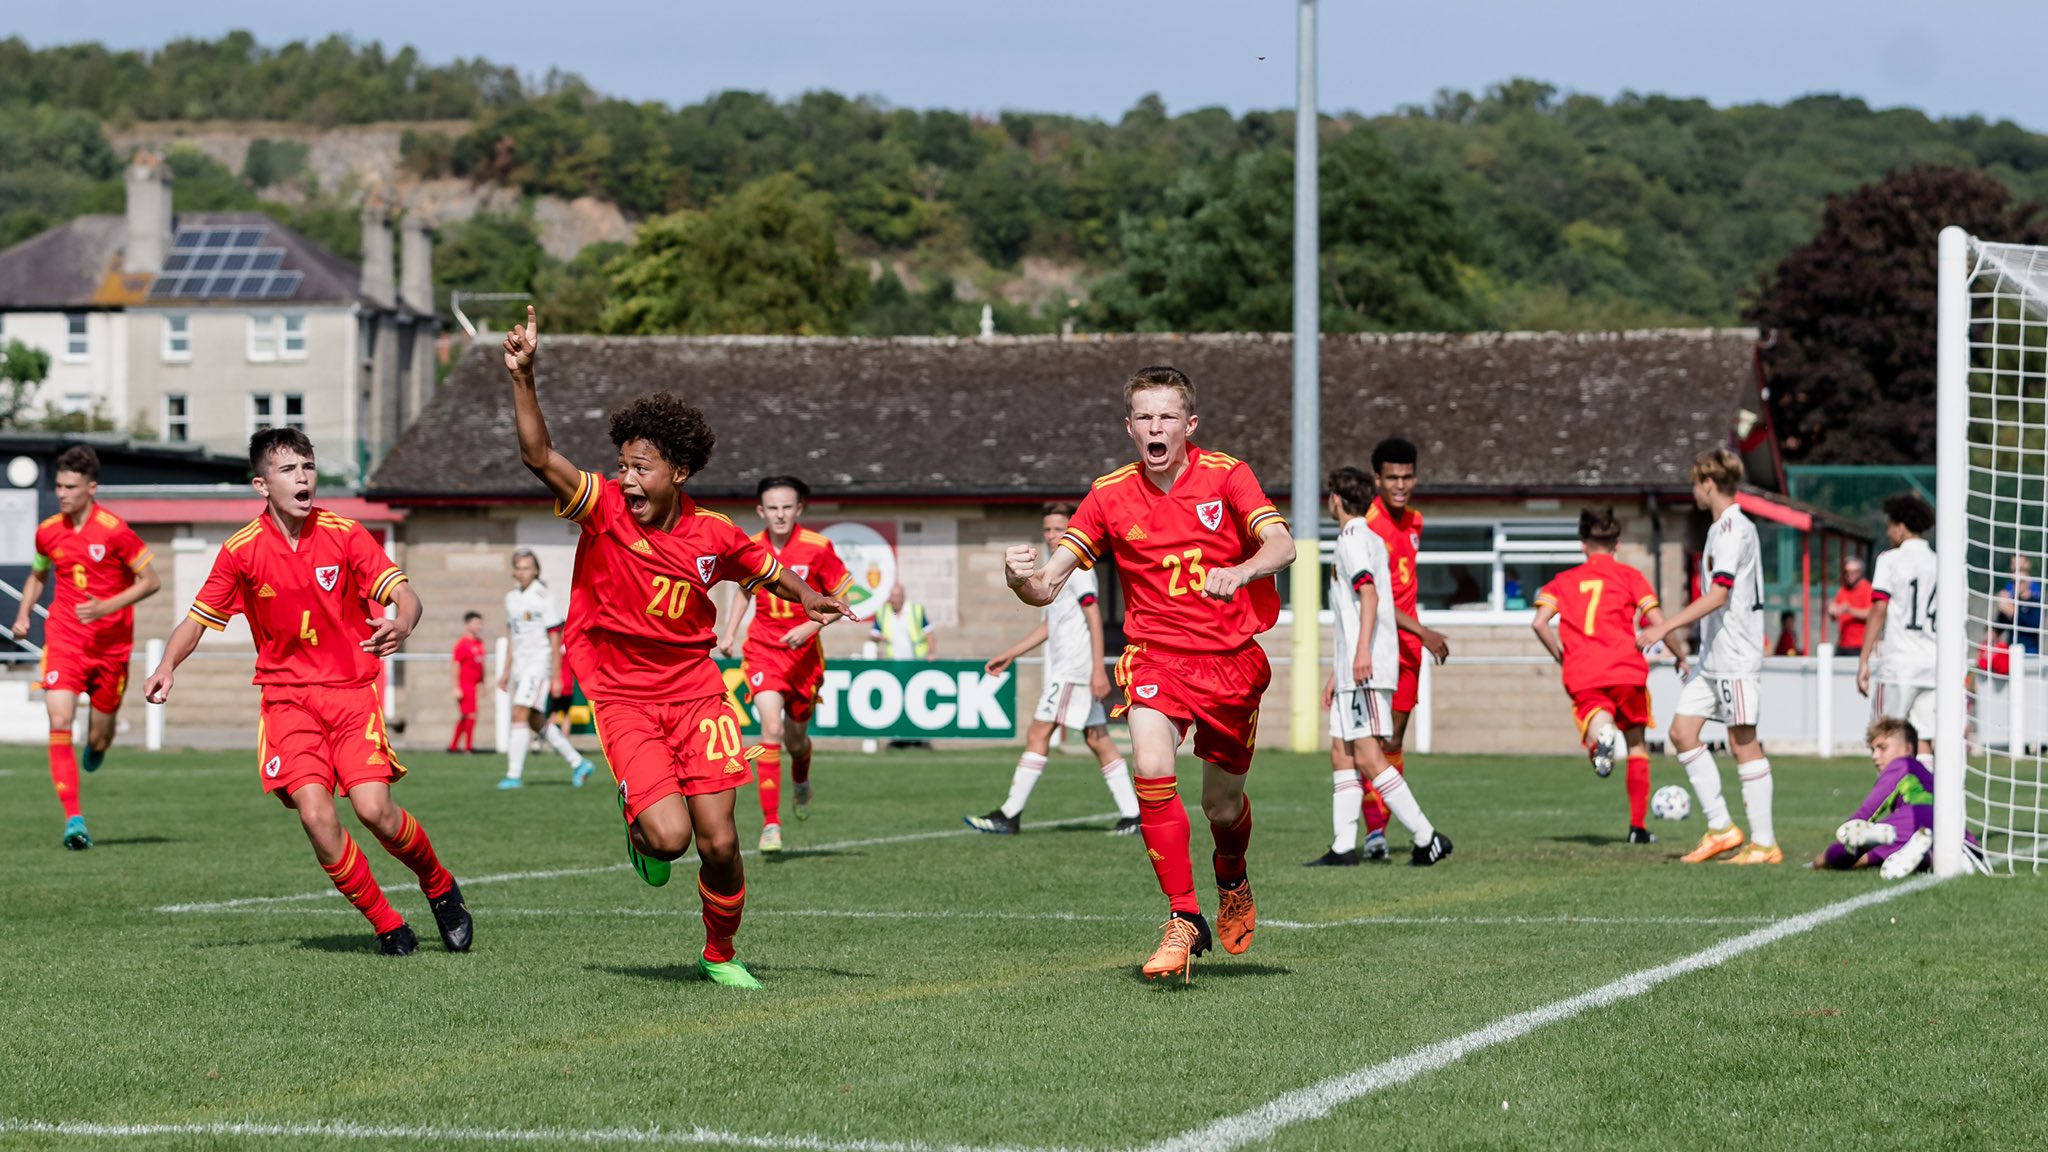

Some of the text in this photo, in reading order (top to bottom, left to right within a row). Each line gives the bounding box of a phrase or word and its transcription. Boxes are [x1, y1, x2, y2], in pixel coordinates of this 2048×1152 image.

[72, 564, 88, 589] 6
[1162, 548, 1207, 597] 23
[1398, 557, 1409, 585] 5
[645, 575, 691, 619] 20
[768, 592, 795, 618] 11
[1579, 579, 1604, 636] 7
[300, 609, 319, 646] 4
[751, 668, 1012, 730] TOCK
[1046, 682, 1060, 705] 2
[1351, 690, 1362, 716] 4
[365, 712, 381, 750] 4
[699, 715, 741, 761] 20
